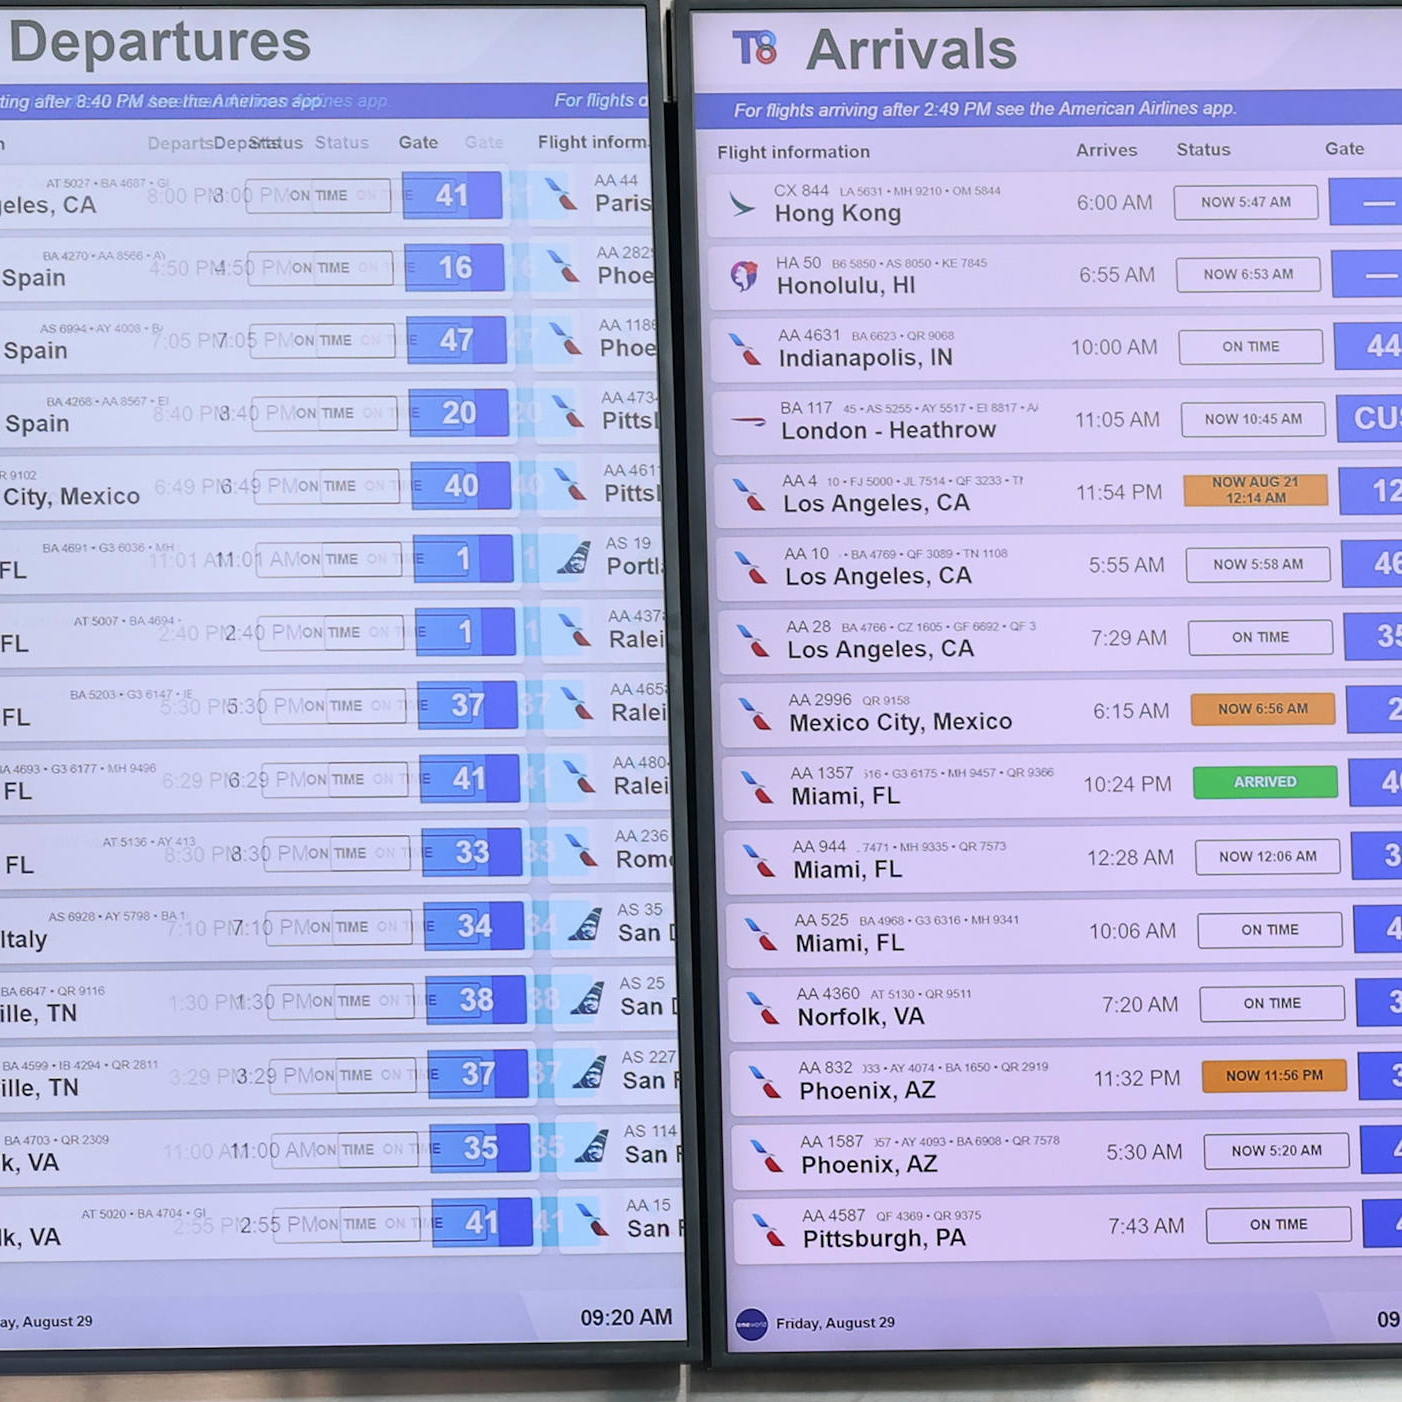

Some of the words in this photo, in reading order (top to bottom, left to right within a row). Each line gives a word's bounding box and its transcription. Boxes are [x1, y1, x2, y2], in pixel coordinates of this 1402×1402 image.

[10, 19, 311, 73] Departures
[731, 29, 778, 65] T8
[805, 26, 1017, 71] Arrivals
[734, 101, 763, 118] For
[766, 102, 816, 121] flights
[818, 104, 880, 121] arriving
[882, 101, 921, 118] after
[923, 101, 961, 118] 2:49
[963, 100, 993, 116] PM
[995, 103, 1026, 116] see
[1029, 101, 1057, 116] the
[1057, 100, 1136, 117] American
[1138, 100, 1199, 116] Airlines
[1202, 103, 1237, 118] app.
[717, 145, 767, 163] Flight
[772, 144, 870, 159] information
[1076, 142, 1138, 157] Arrives
[1177, 142, 1231, 157] Status
[1325, 141, 1365, 156] Gate
[774, 183, 797, 197] CX
[801, 183, 830, 197] 844
[1077, 194, 1118, 211] 6:00
[1121, 193, 1153, 211] AM
[1201, 196, 1236, 208] NOW
[1239, 196, 1266, 208] 5:47
[1269, 196, 1291, 208] AM
[775, 204, 834, 227] Hong
[842, 203, 901, 226] Kong
[440, 256, 472, 279] 16
[2, 268, 66, 292] Spain
[777, 275, 885, 295] Honolulu,
[893, 275, 915, 294] HI
[3, 487, 53, 511] City,
[60, 486, 140, 506] Mexico
[1234, 774, 1298, 788] ARRIVED
[1226, 1070, 1261, 1082] NOW
[1264, 1069, 1299, 1081] 11:56
[1302, 1069, 1324, 1081] PM
[802, 1209, 826, 1223] AA
[828, 1208, 866, 1222] 4587
[1250, 1218, 1271, 1231] ON
[1275, 1218, 1308, 1230] TIME
[1109, 1217, 1150, 1235] 7:43
[1153, 1217, 1185, 1235] AM
[29, 1227, 62, 1246] VA
[803, 1228, 928, 1252] Pittsburgh,
[936, 1227, 967, 1247] PA
[22, 1315, 74, 1331] August
[76, 1315, 93, 1327] 29
[580, 1308, 634, 1327] 09:20
[639, 1308, 673, 1326] AM
[776, 1317, 819, 1332] Friday,
[825, 1317, 876, 1332] August
[879, 1316, 895, 1328] 29
